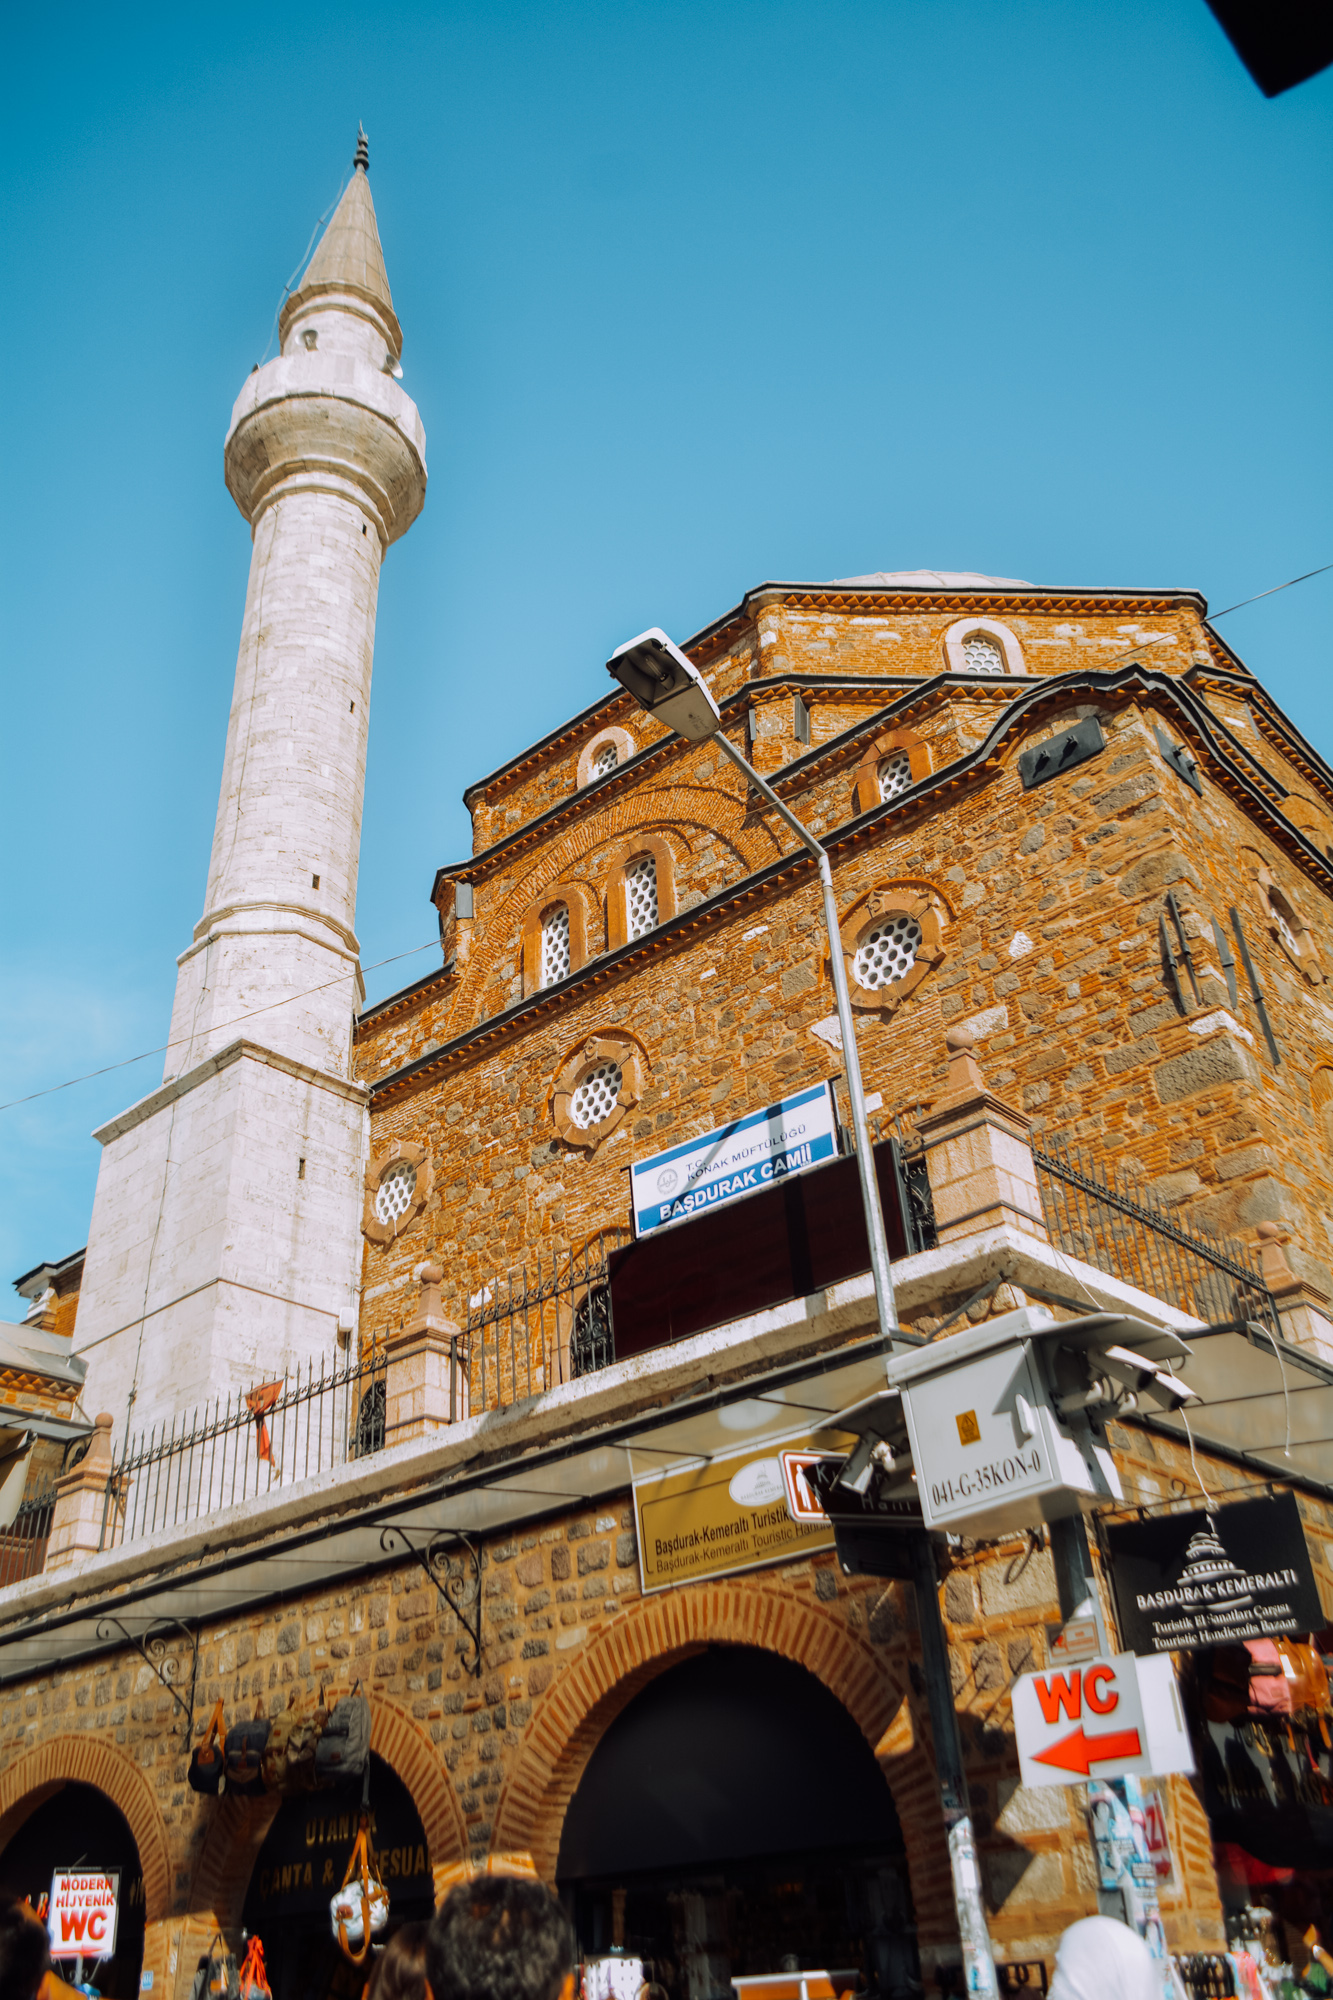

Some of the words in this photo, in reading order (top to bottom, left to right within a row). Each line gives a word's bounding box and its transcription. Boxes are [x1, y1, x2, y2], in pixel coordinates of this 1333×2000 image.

[686, 1159, 706, 1171] T.C.
[687, 1158, 729, 1183] KONAK
[731, 1124, 807, 1163] MÜFTÜLÜĞÜ
[659, 1168, 757, 1221] BAŞDURAK
[760, 1142, 813, 1179] CAMİİ
[931, 1449, 1042, 1507] 041-G-35KON-0
[655, 1516, 750, 1559] Başdurak-Kemeraltı
[751, 1504, 790, 1531] Turistik
[655, 1537, 750, 1574] Başdurak-Kemeraltı
[751, 1525, 793, 1549] Touristic
[1136, 1569, 1299, 1611] BAŞDURAK-KEMERALTI
[1152, 1614, 1194, 1635] Turistik
[1152, 1632, 1198, 1651] Touristic
[1199, 1622, 1260, 1643] Handicrafts
[1260, 1617, 1298, 1635] Bazaar
[1032, 1663, 1119, 1724] WC
[305, 1807, 378, 1848] OTANTK
[56, 1889, 115, 1908] HİJYENİK
[61, 1876, 114, 1892] MODERN
[61, 1909, 107, 1942] WC
